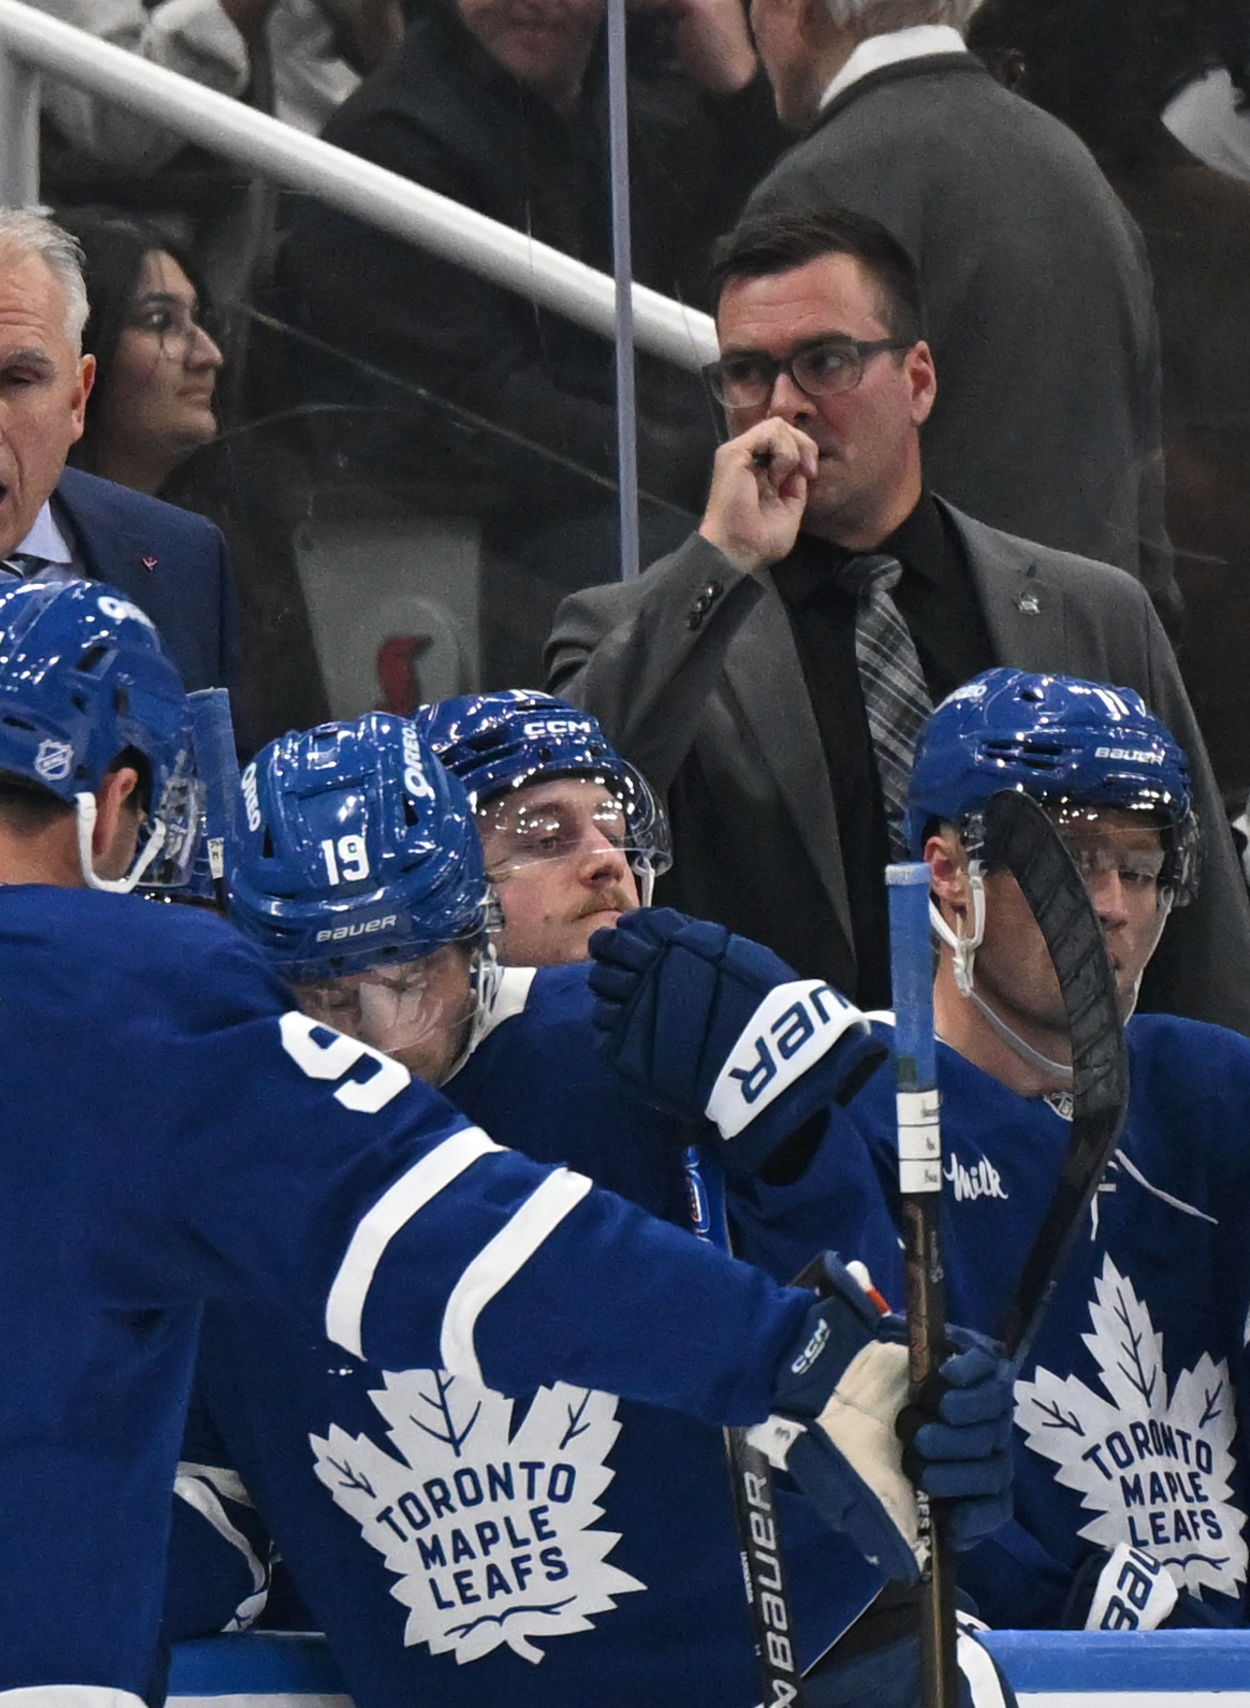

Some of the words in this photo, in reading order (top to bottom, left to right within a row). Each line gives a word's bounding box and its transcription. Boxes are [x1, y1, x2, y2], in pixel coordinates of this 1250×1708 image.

[524, 720, 591, 736] CCM
[321, 835, 370, 886] 19
[316, 914, 398, 943] BAUER
[943, 1152, 1009, 1202] Milk
[1081, 1418, 1213, 1481] TORONTO
[376, 1461, 576, 1543] TORONTO
[1119, 1471, 1209, 1508] MAPLE
[415, 1504, 558, 1571] MAPLE
[1127, 1508, 1223, 1548] LEAFS
[428, 1546, 569, 1610] LEAFS
[744, 1471, 794, 1673] BAUER
